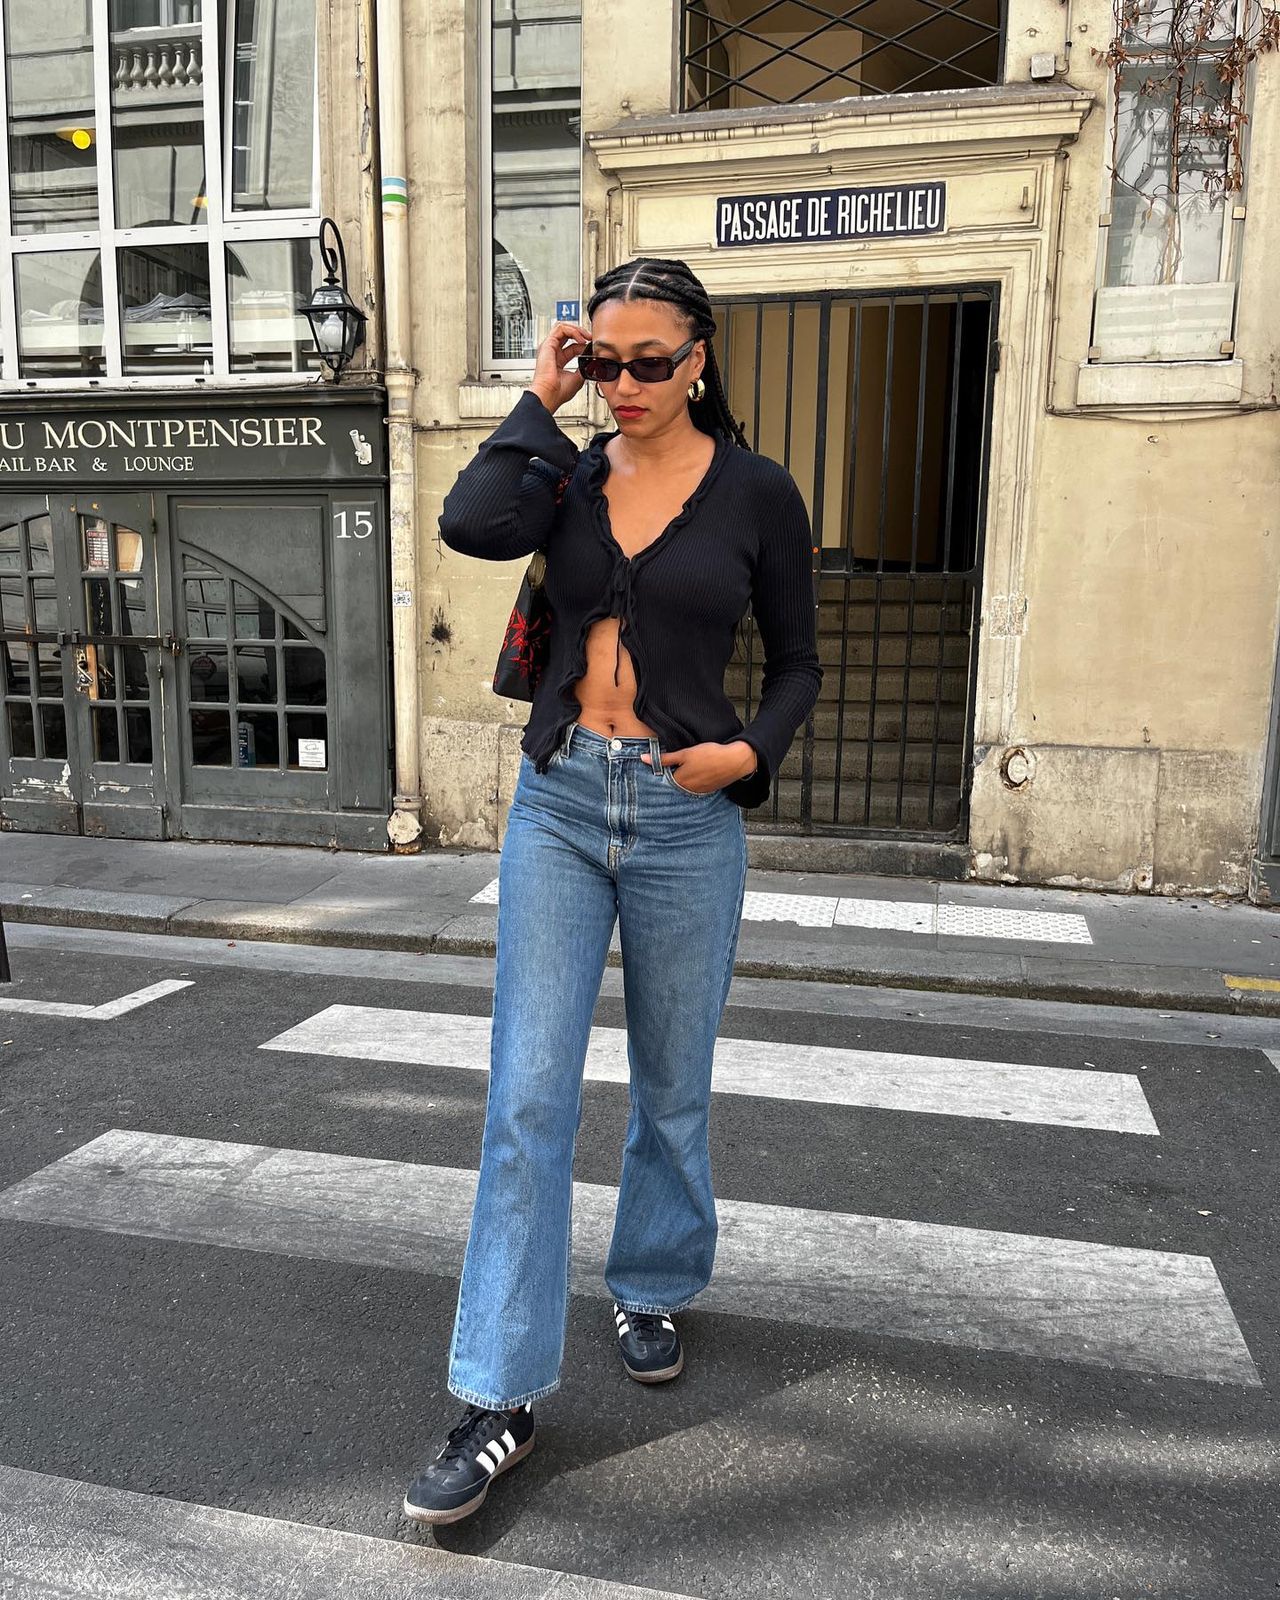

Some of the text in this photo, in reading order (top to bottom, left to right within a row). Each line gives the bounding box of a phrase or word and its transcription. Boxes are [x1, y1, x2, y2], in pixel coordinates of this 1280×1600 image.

[720, 189, 941, 242] PASSAGE DE RICHELIEU
[0, 417, 326, 450] U MONTPENSIER
[34, 457, 77, 472] BAR
[92, 457, 108, 472] &
[124, 456, 194, 471] LOUNGE
[333, 511, 373, 539] 15
